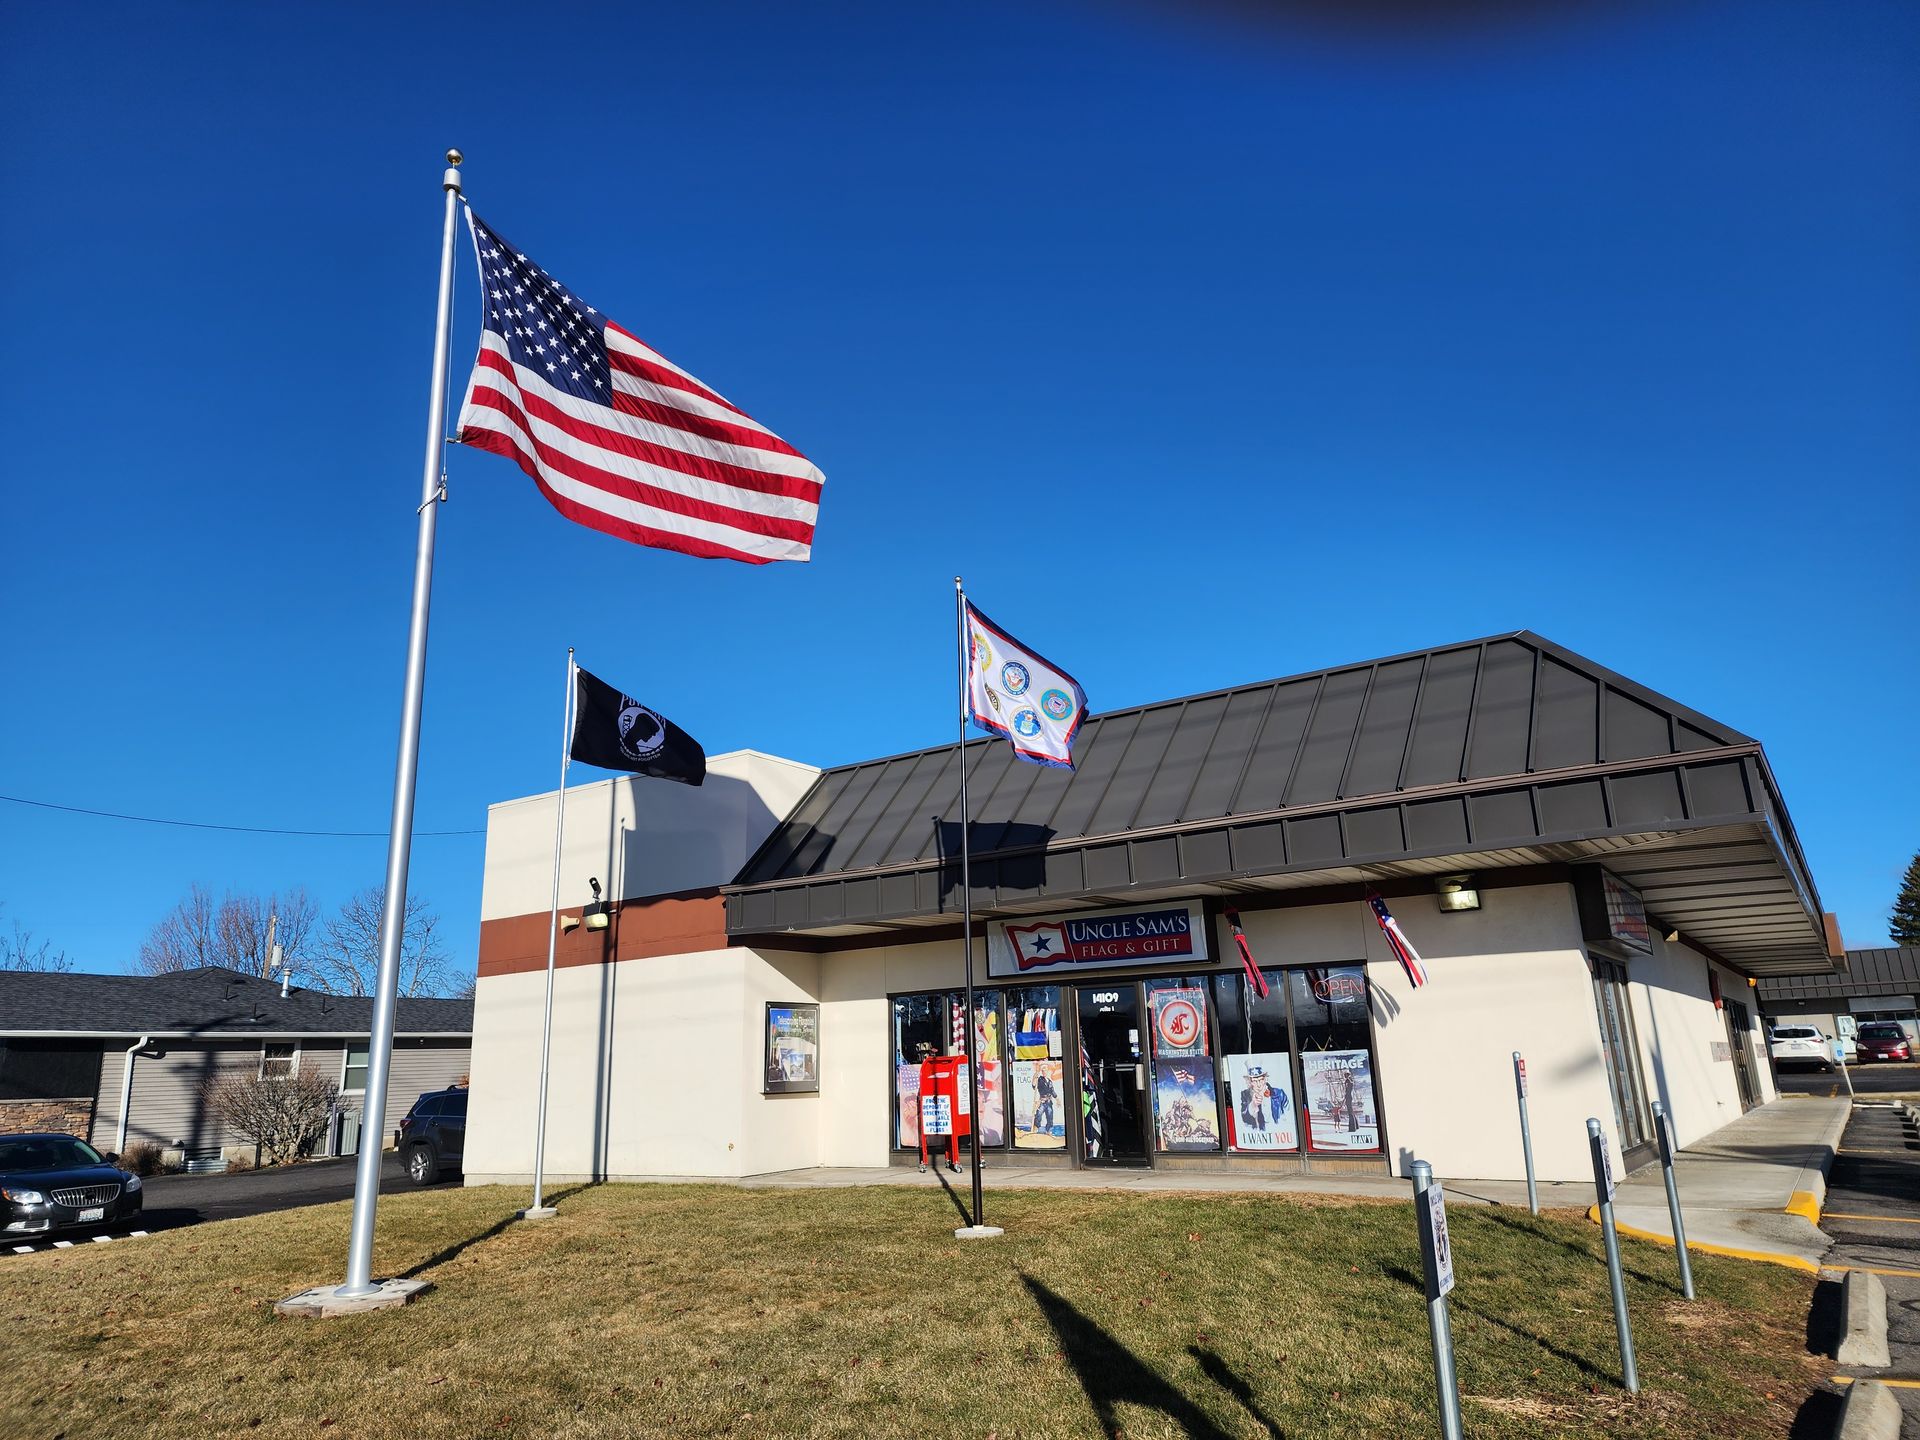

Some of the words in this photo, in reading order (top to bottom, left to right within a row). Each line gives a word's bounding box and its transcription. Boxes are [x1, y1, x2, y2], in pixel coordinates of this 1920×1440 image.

[1071, 921, 1131, 941] UNCLE
[1136, 915, 1187, 936] SAM'S
[1082, 943, 1118, 957] FLAG
[1125, 942, 1136, 954] &
[1143, 938, 1180, 952] GIFT
[1314, 978, 1364, 997] OPEN
[1092, 992, 1119, 1004] 14109
[1308, 1059, 1364, 1071] HERITAGE
[1016, 1076, 1032, 1084] FLAG
[1243, 1132, 1247, 1144] I
[1248, 1132, 1273, 1145] WANT
[1275, 1131, 1293, 1144] YOU
[1351, 1134, 1373, 1144] NAVY
